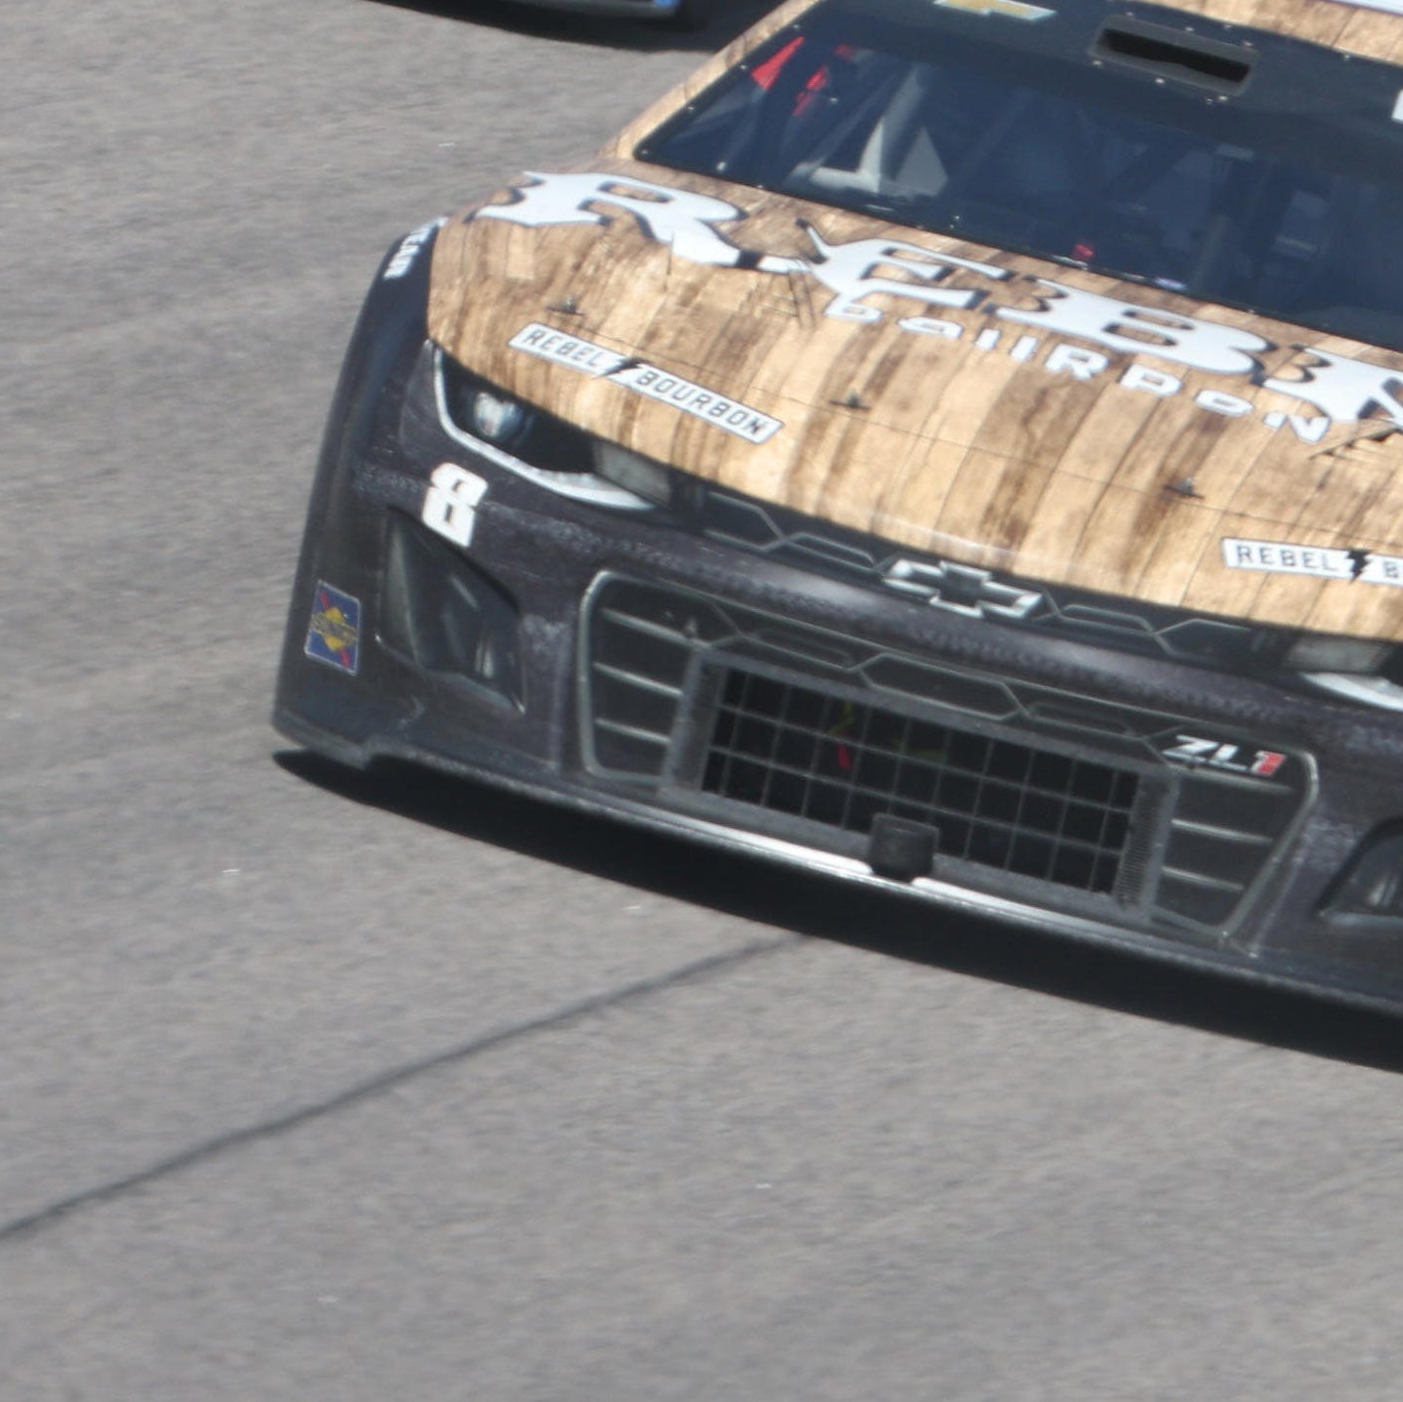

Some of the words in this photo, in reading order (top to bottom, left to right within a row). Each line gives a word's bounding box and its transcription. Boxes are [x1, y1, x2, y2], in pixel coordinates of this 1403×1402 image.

[523, 330, 600, 367] REBEL
[636, 370, 767, 435] BOURBON
[421, 461, 489, 549] 8
[1236, 544, 1339, 573] REBEL
[1162, 734, 1287, 778] ZL1
